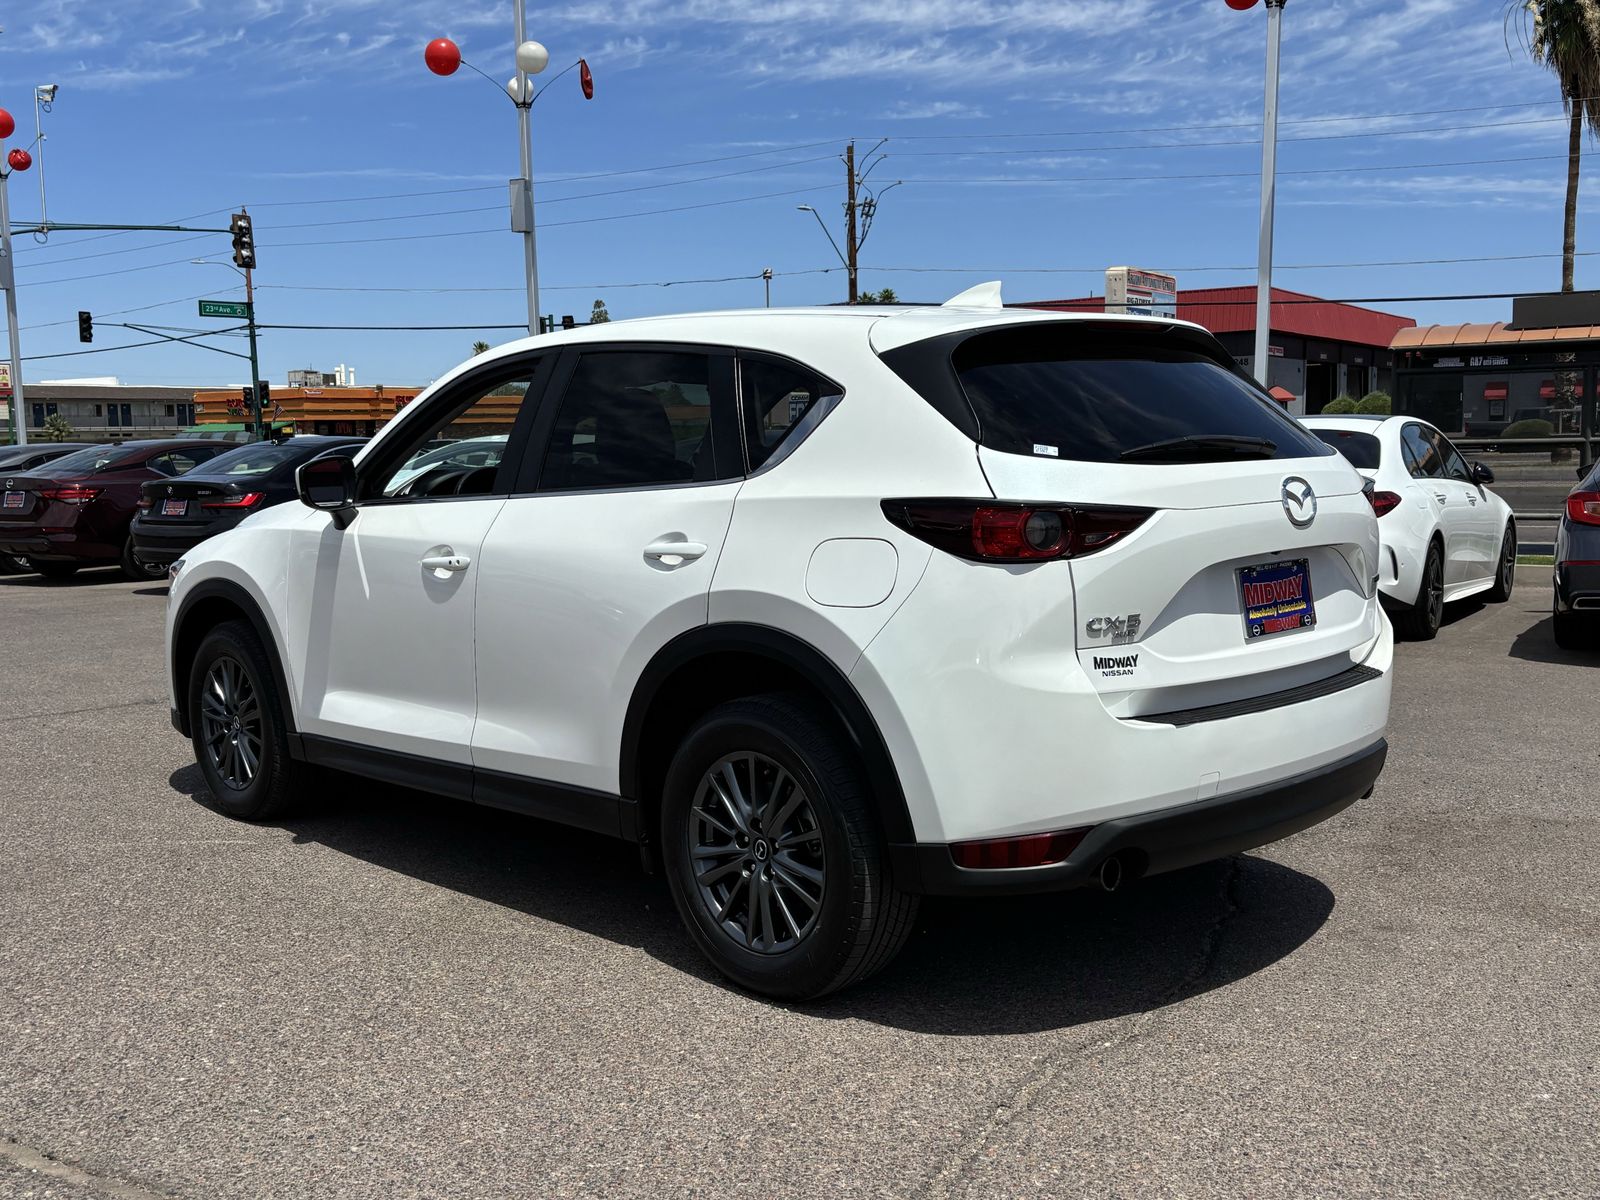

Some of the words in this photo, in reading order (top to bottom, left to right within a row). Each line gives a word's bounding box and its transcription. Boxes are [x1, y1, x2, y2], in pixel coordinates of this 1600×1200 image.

[205, 305, 218, 313] 23rd
[219, 306, 233, 314] Ave.
[1244, 573, 1303, 608] MIDWAY
[1249, 606, 1278, 620] Absolutely
[1086, 613, 1141, 634] CX-5
[1093, 653, 1139, 670] MIDWAY
[1102, 668, 1134, 677] NISSAN
